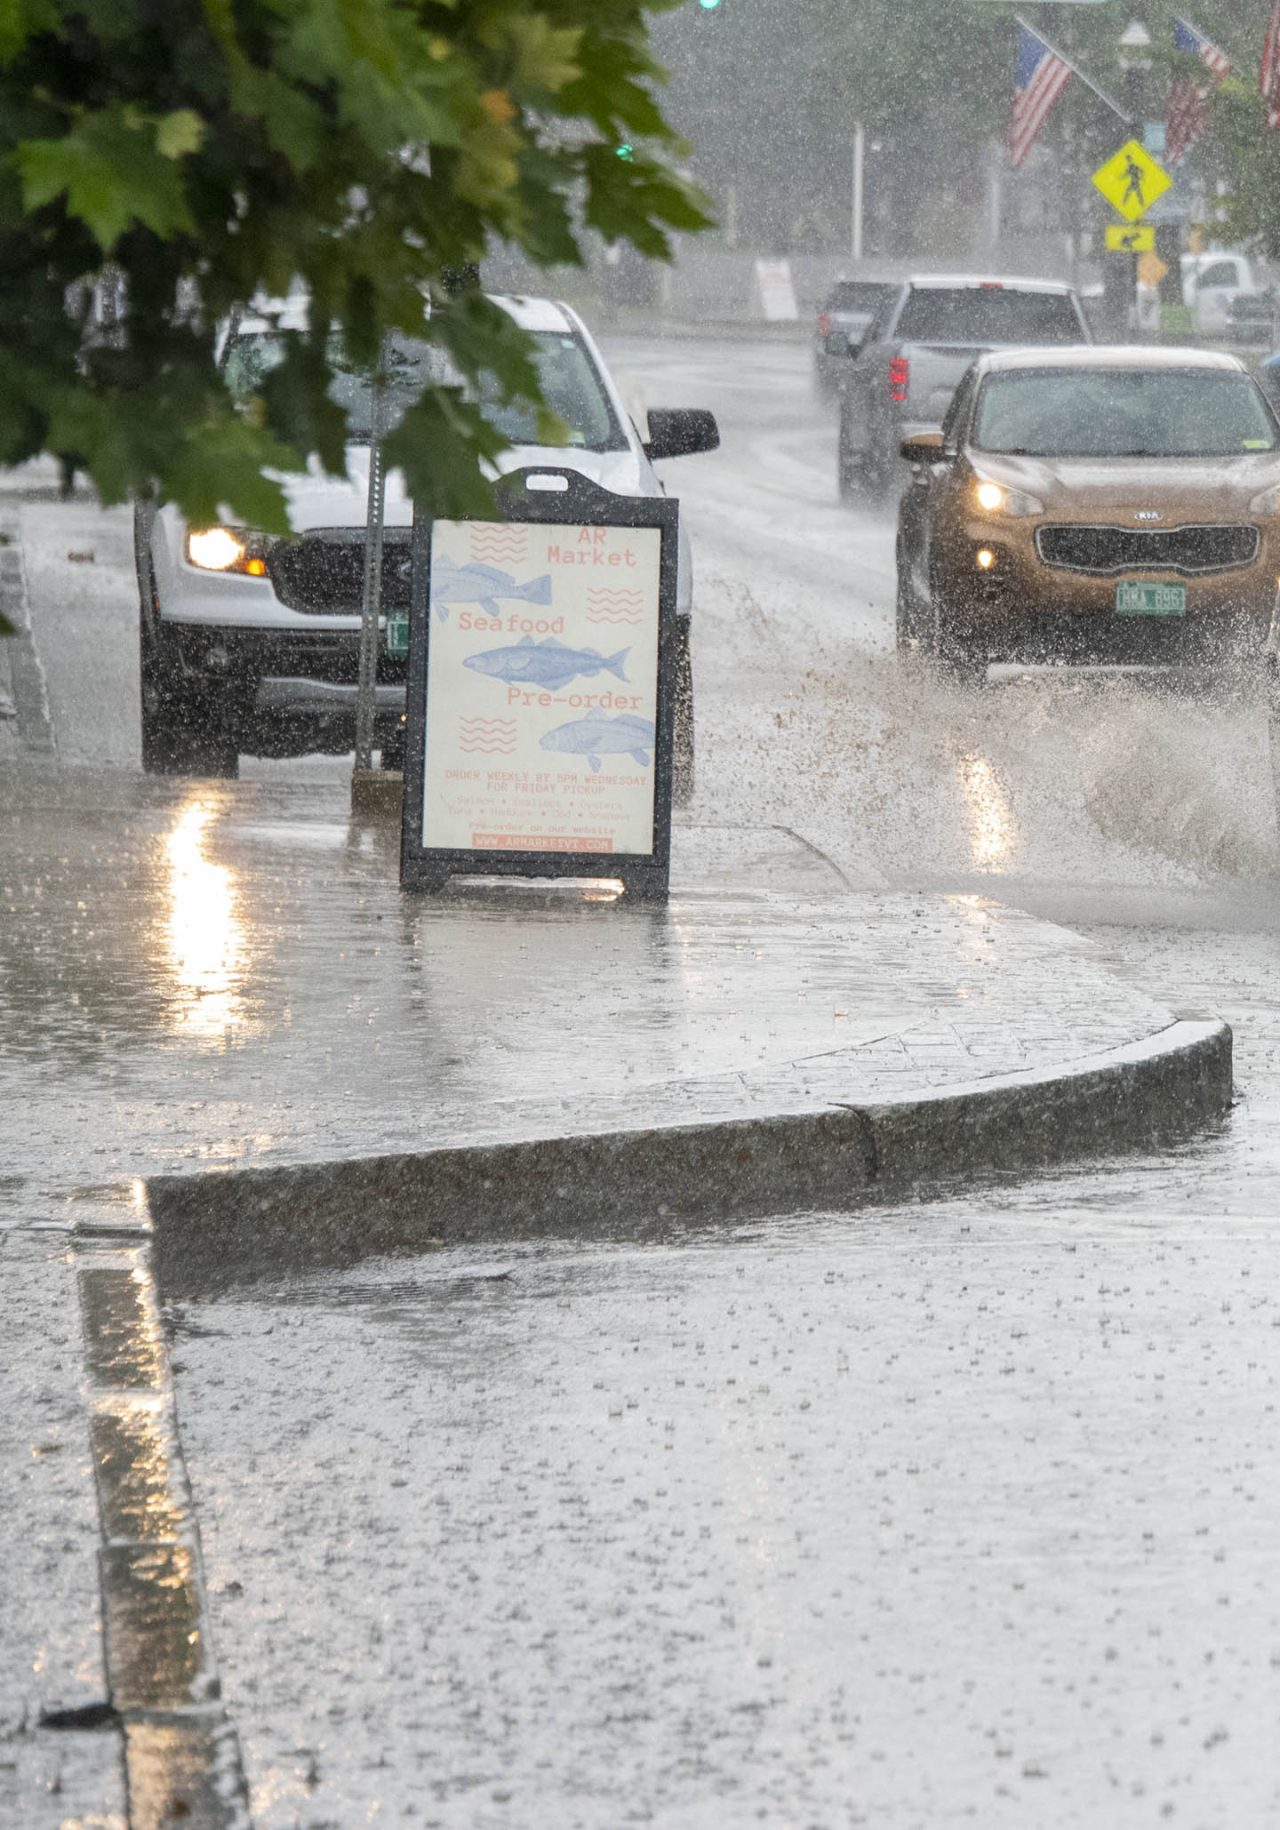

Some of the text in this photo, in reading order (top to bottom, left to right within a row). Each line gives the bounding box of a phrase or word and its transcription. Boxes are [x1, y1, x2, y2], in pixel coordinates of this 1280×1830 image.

[577, 527, 607, 544] AR
[547, 545, 637, 566] Market
[458, 611, 564, 634] Seafood
[507, 686, 643, 710] Pre-order
[445, 770, 480, 780] ORDER
[487, 771, 528, 782] WEEKLY
[584, 775, 646, 786] WEDNESDAY
[487, 782, 605, 794] FOR FRIDAY PICKUP
